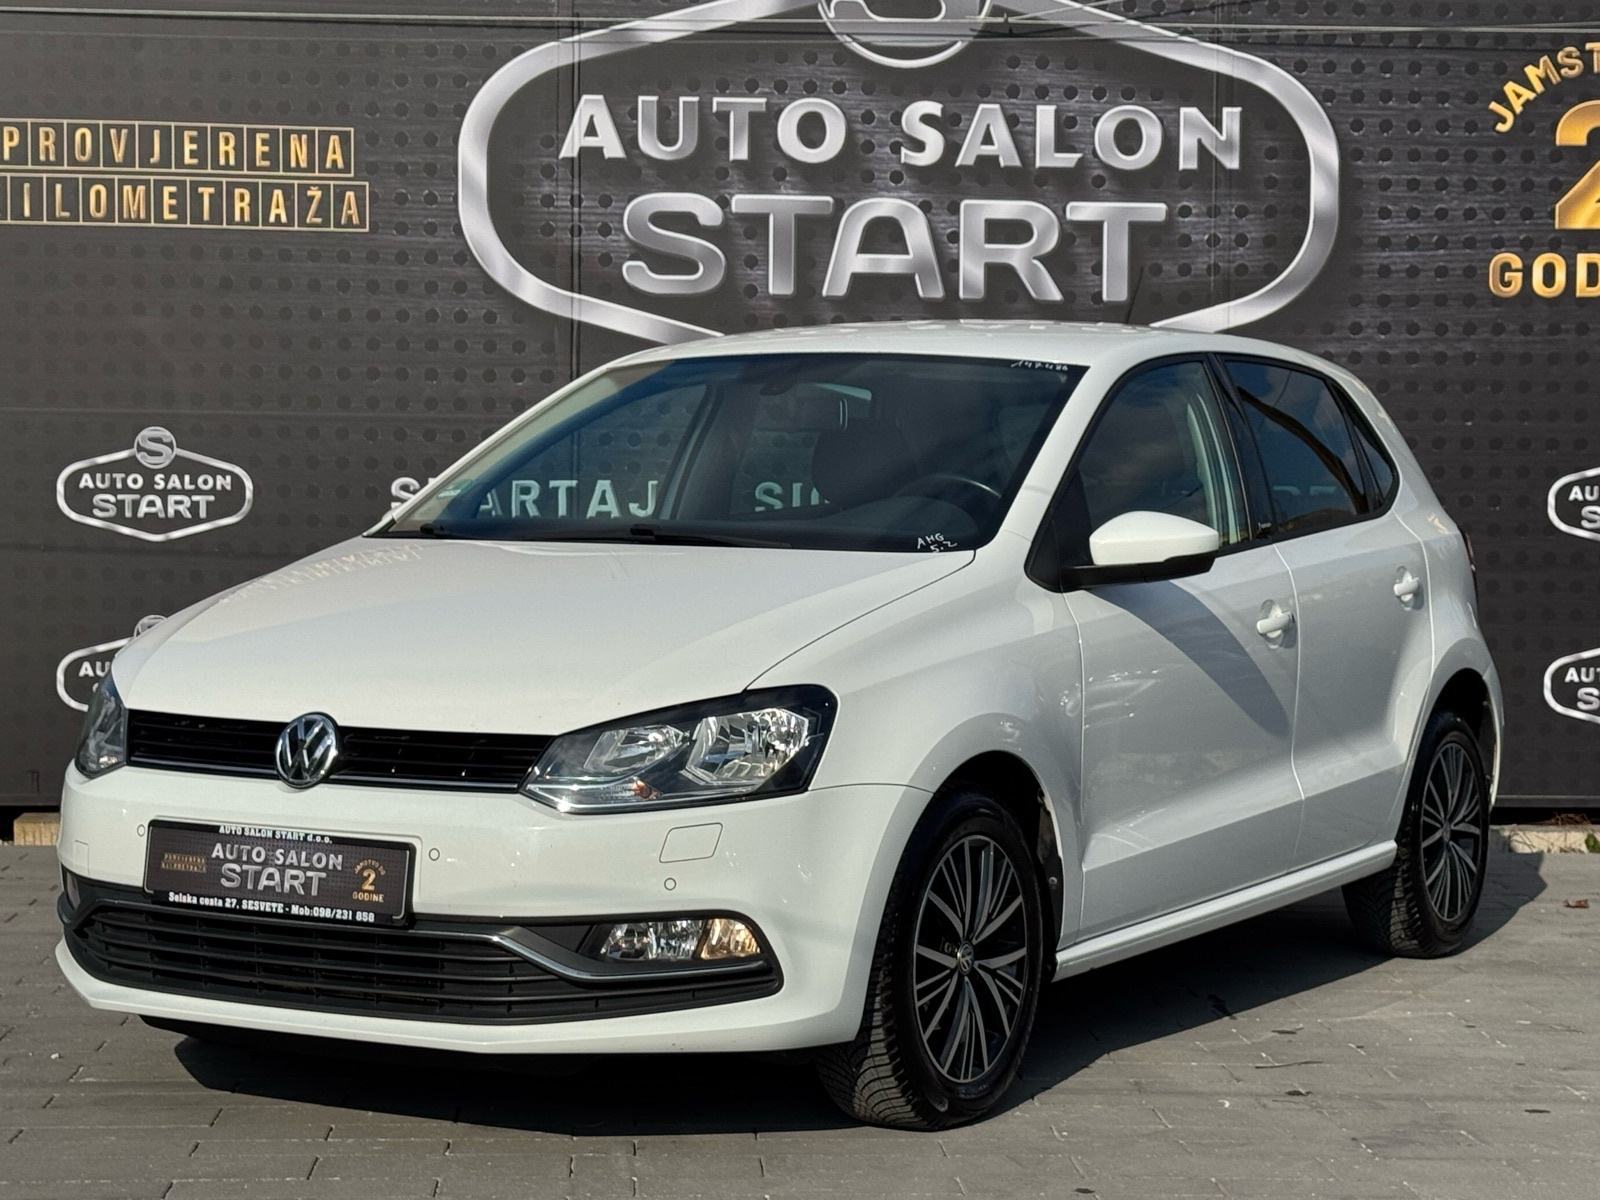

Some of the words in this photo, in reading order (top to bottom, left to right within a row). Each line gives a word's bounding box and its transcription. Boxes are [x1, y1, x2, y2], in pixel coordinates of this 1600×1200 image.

[559, 94, 848, 164] AUTO
[899, 101, 1243, 171] SALON
[2, 126, 345, 170] PROVJERENA
[23, 183, 361, 226] ILOMETRAŽA
[621, 192, 1168, 302] START
[79, 473, 144, 489] AUTO
[154, 474, 232, 491] SALON
[92, 494, 215, 519] START
[1564, 667, 1600, 683] AU
[219, 825, 242, 835] AUTO
[244, 827, 273, 838] SALON
[275, 830, 305, 841] START
[211, 843, 266, 863] AUTO
[274, 849, 343, 871] SALON
[220, 863, 327, 896] START
[362, 868, 376, 890] 2
[168, 891, 198, 905] Selska
[241, 899, 284, 913] SESVETE
[352, 891, 385, 902] GODINE
